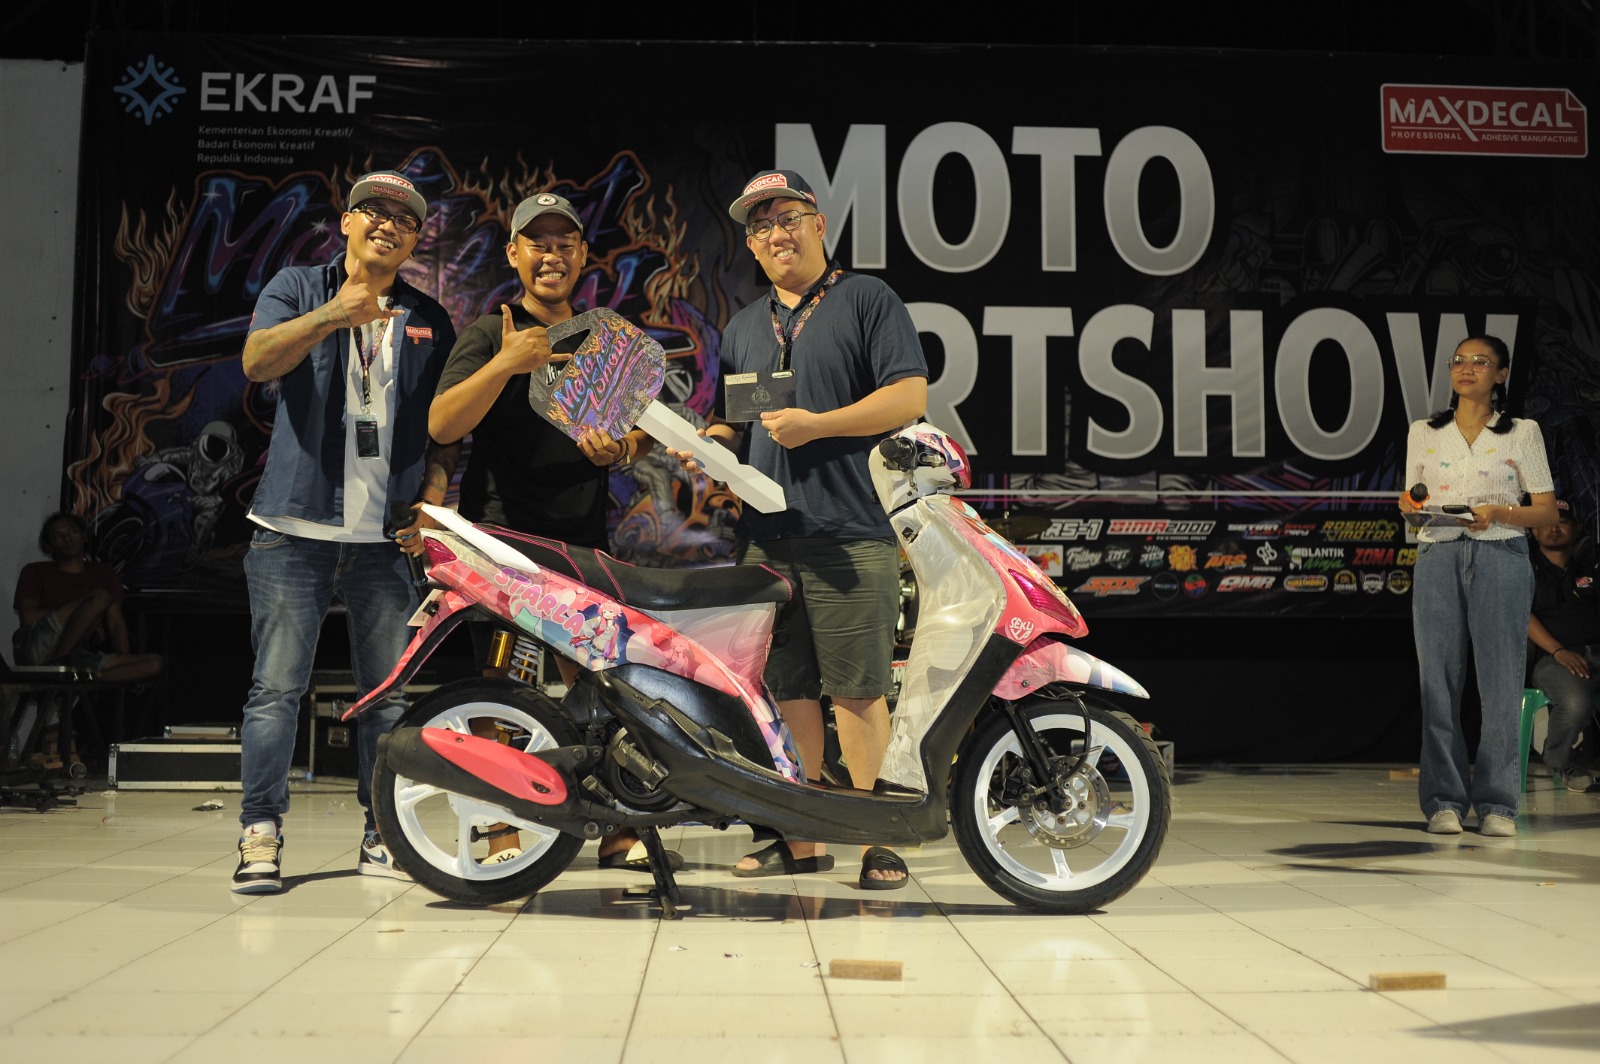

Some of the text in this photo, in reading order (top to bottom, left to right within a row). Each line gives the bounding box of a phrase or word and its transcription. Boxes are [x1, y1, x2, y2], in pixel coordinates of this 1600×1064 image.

[201, 72, 377, 114] EKRAF
[1389, 96, 1574, 142] MAXDECAL
[199, 126, 354, 138] Kementerian Ekonomi Kreatif/
[1391, 131, 1579, 144] PROFESSIONAL ADHESIVE MANUFACTURE
[198, 139, 315, 151] Badan Ekonomi Kreatif
[197, 153, 294, 165] Republik Indonesia
[775, 121, 1215, 275] MOTO
[903, 302, 1519, 460] RTSHOW
[1301, 547, 1344, 558] BLANTIK
[1352, 547, 1395, 567] ZONA
[494, 567, 586, 637] STARLA
